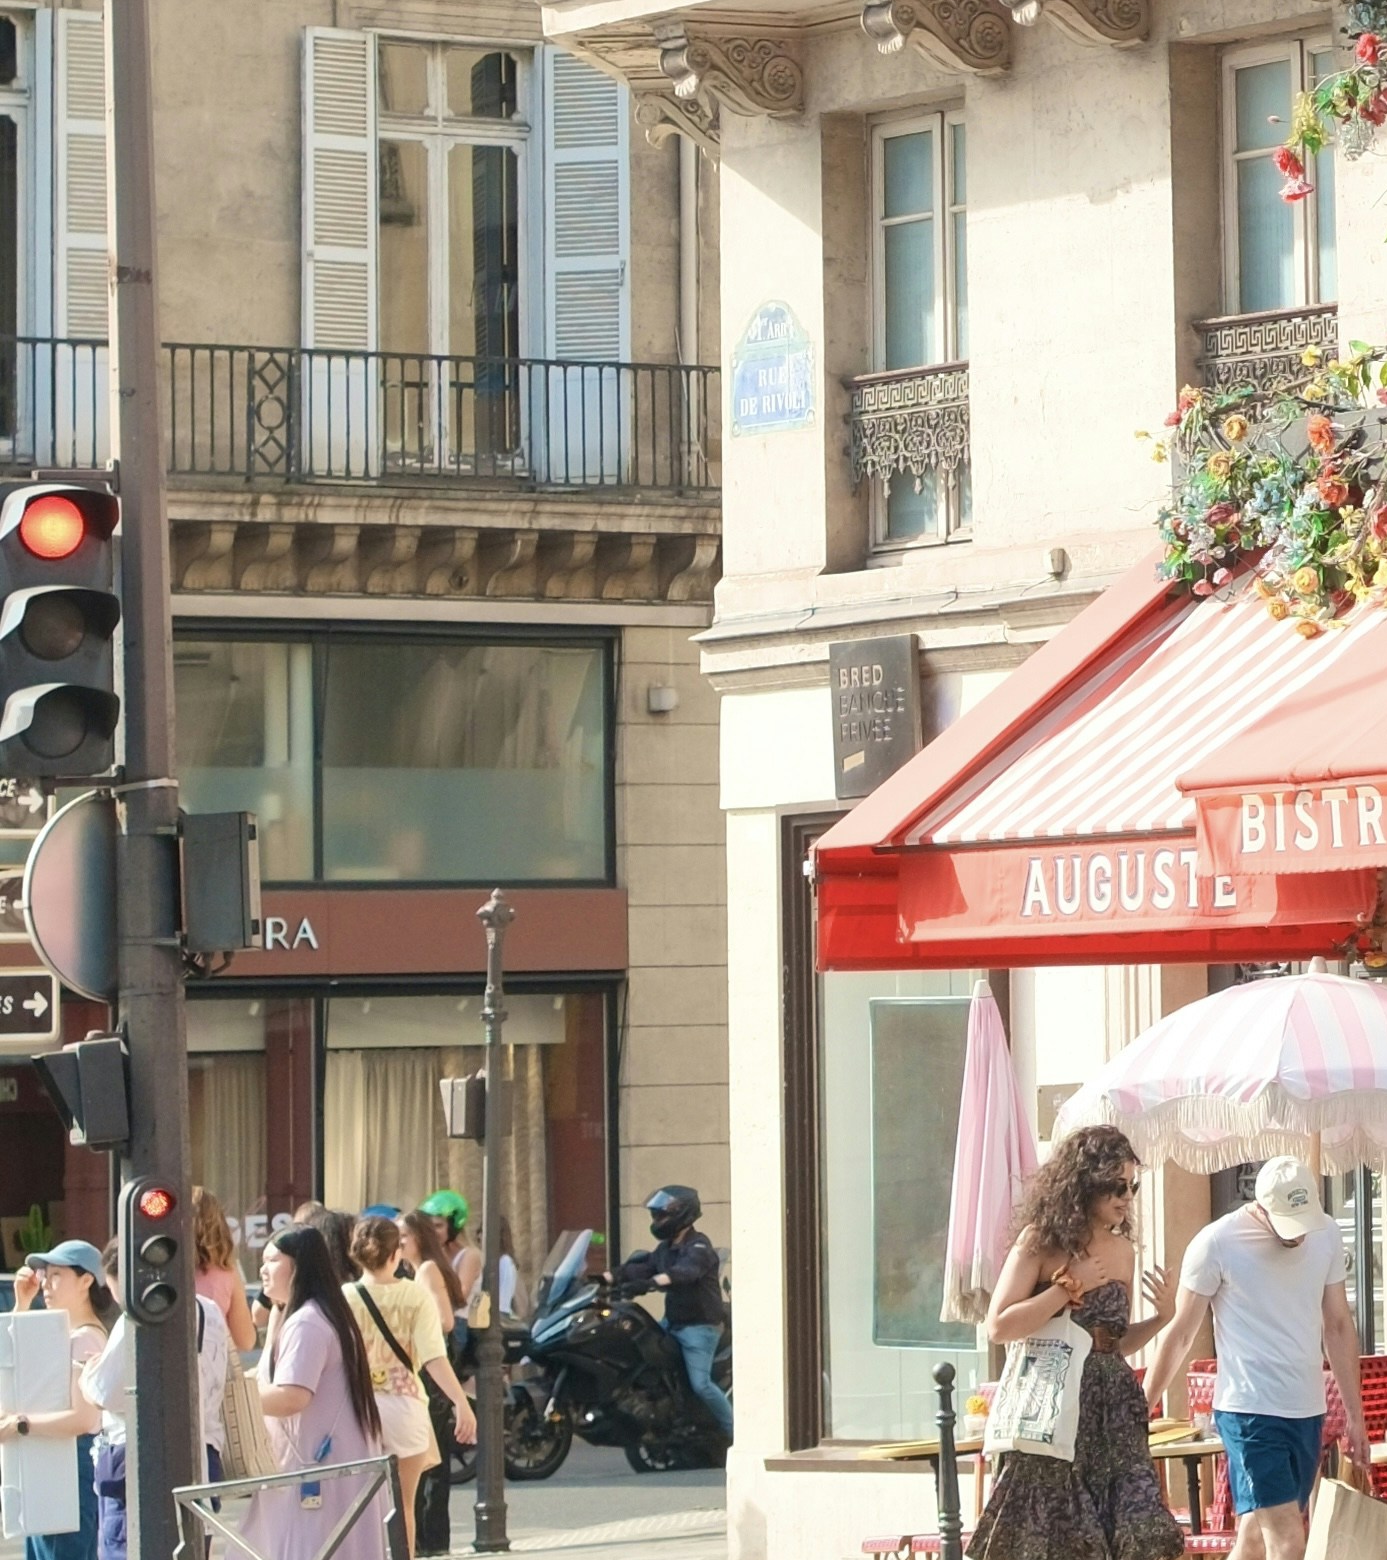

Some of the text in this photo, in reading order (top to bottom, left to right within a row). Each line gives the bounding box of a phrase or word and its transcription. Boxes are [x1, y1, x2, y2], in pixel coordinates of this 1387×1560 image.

[758, 364, 787, 388] RUE
[740, 390, 806, 418] DE RIVOLI
[839, 664, 884, 690] BRED
[839, 686, 905, 718] BANQUE
